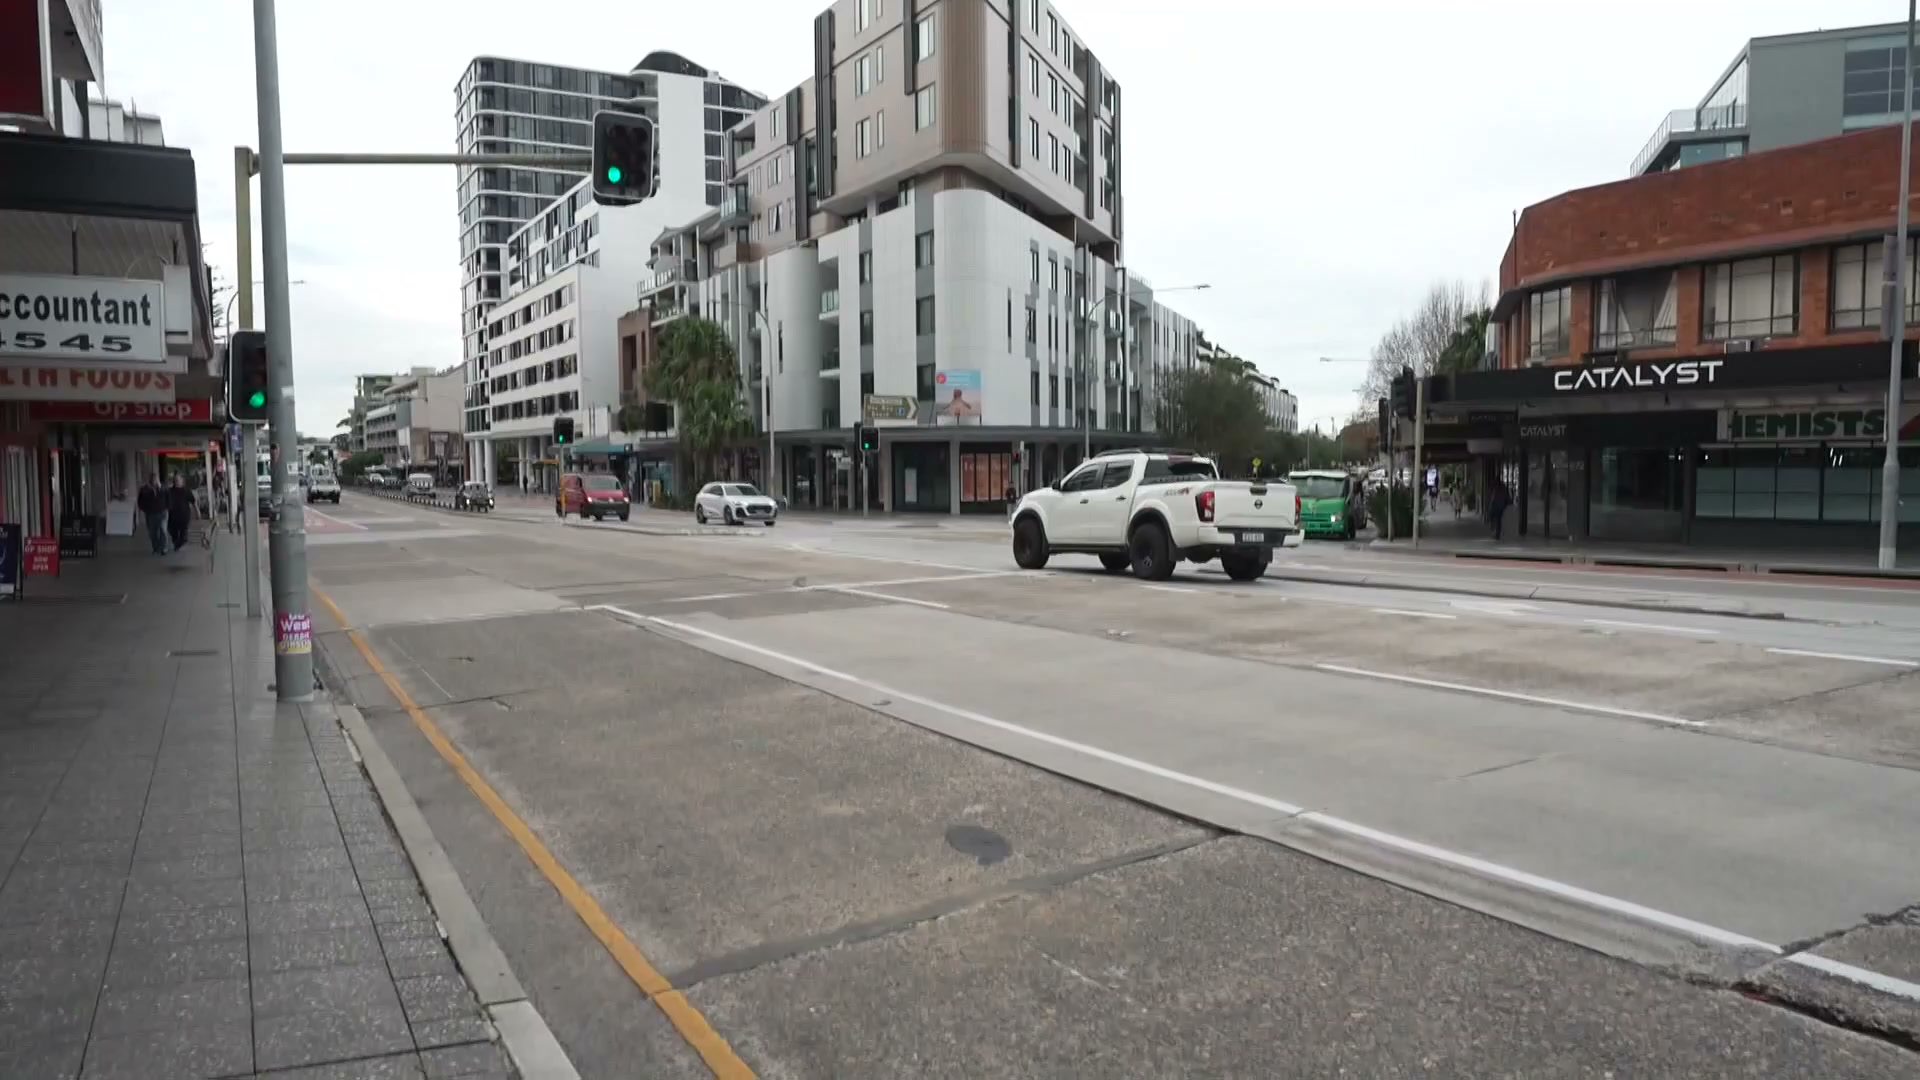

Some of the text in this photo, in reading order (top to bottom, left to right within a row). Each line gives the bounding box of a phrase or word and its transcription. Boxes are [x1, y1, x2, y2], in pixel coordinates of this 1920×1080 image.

[0, 332, 132, 353] 545
[69, 367, 171, 391] FOODS
[1553, 360, 1724, 392] CATALYST
[95, 402, 192, 420] Op Shop
[1520, 424, 1568, 437] CATALYST
